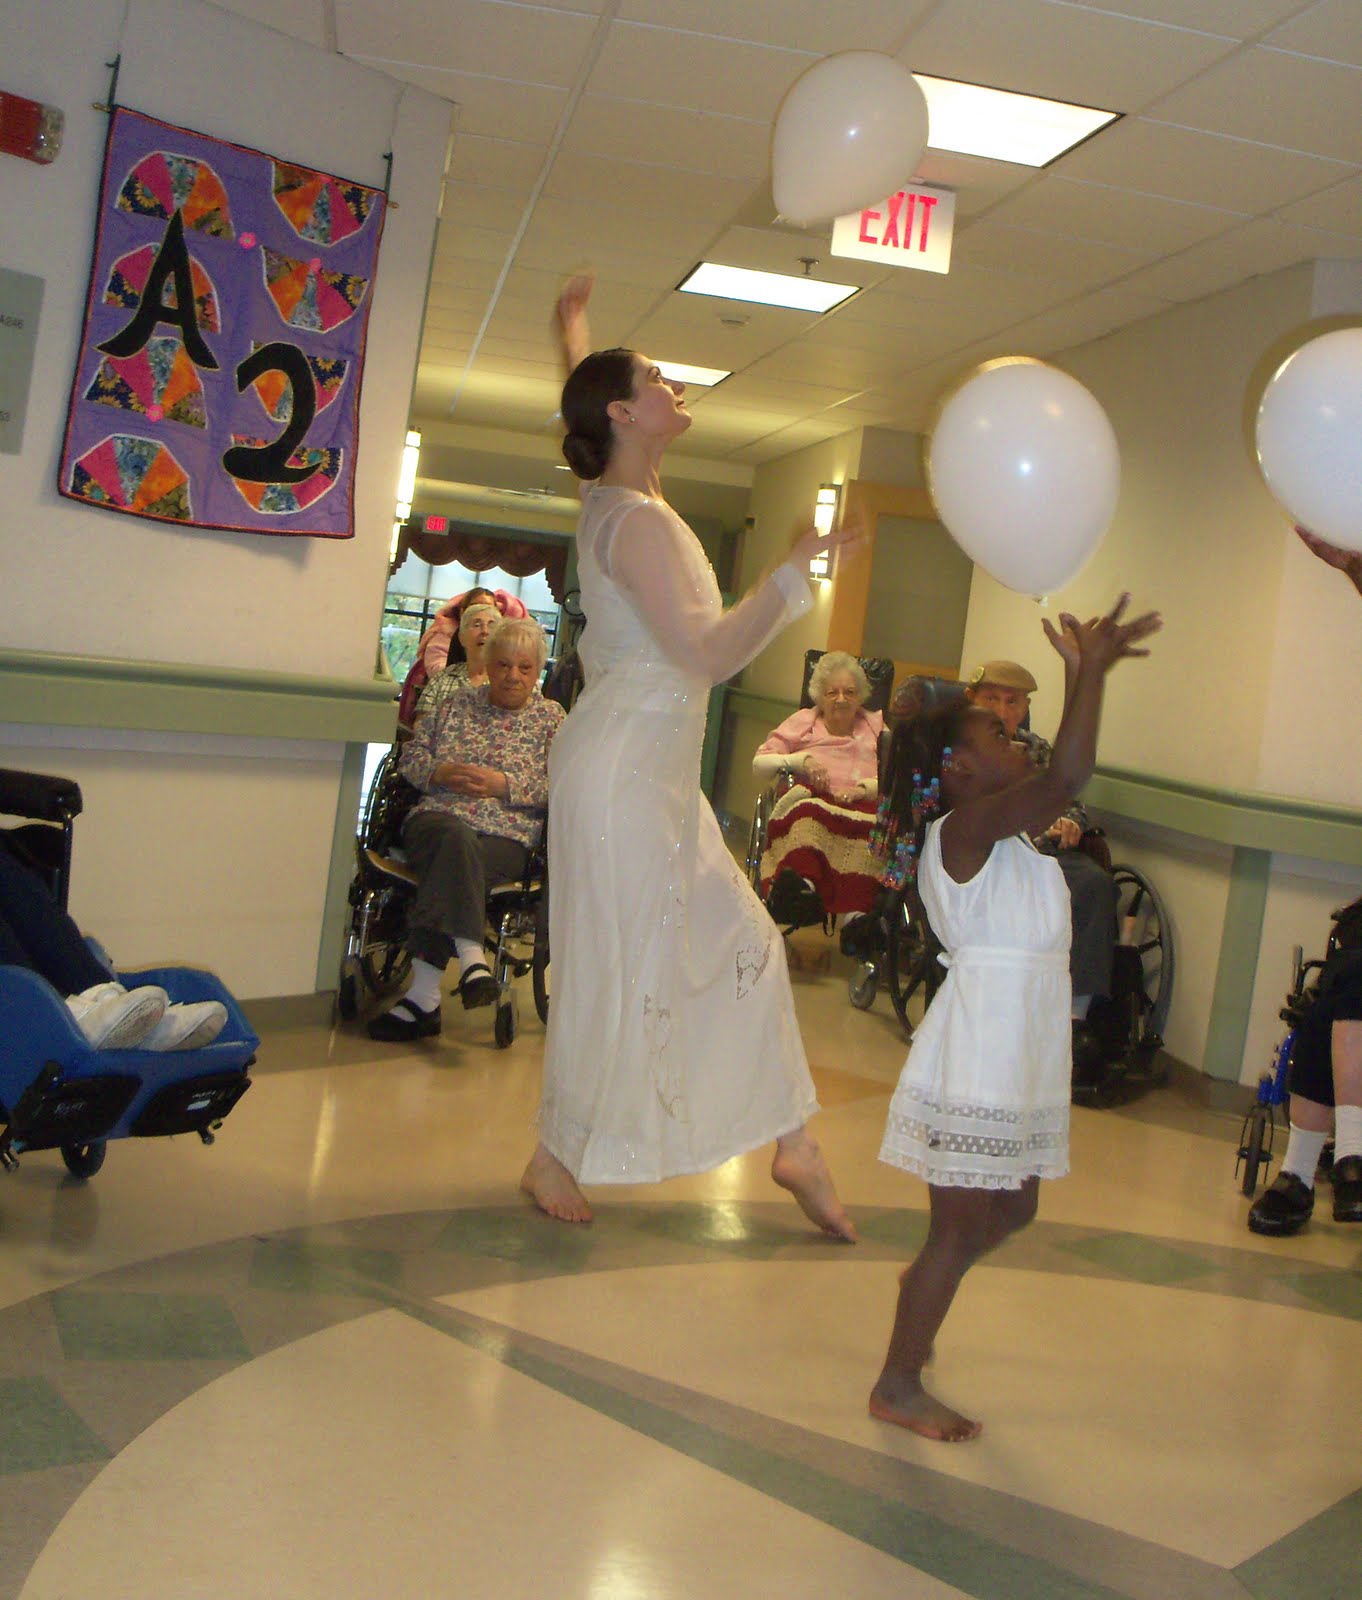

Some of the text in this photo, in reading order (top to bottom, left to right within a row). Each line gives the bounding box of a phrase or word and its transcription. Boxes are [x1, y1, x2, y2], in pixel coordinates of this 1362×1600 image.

[858, 191, 938, 253] EXIT
[96, 208, 221, 371] A
[222, 342, 325, 485] 2
[425, 515, 448, 532] EXIT
